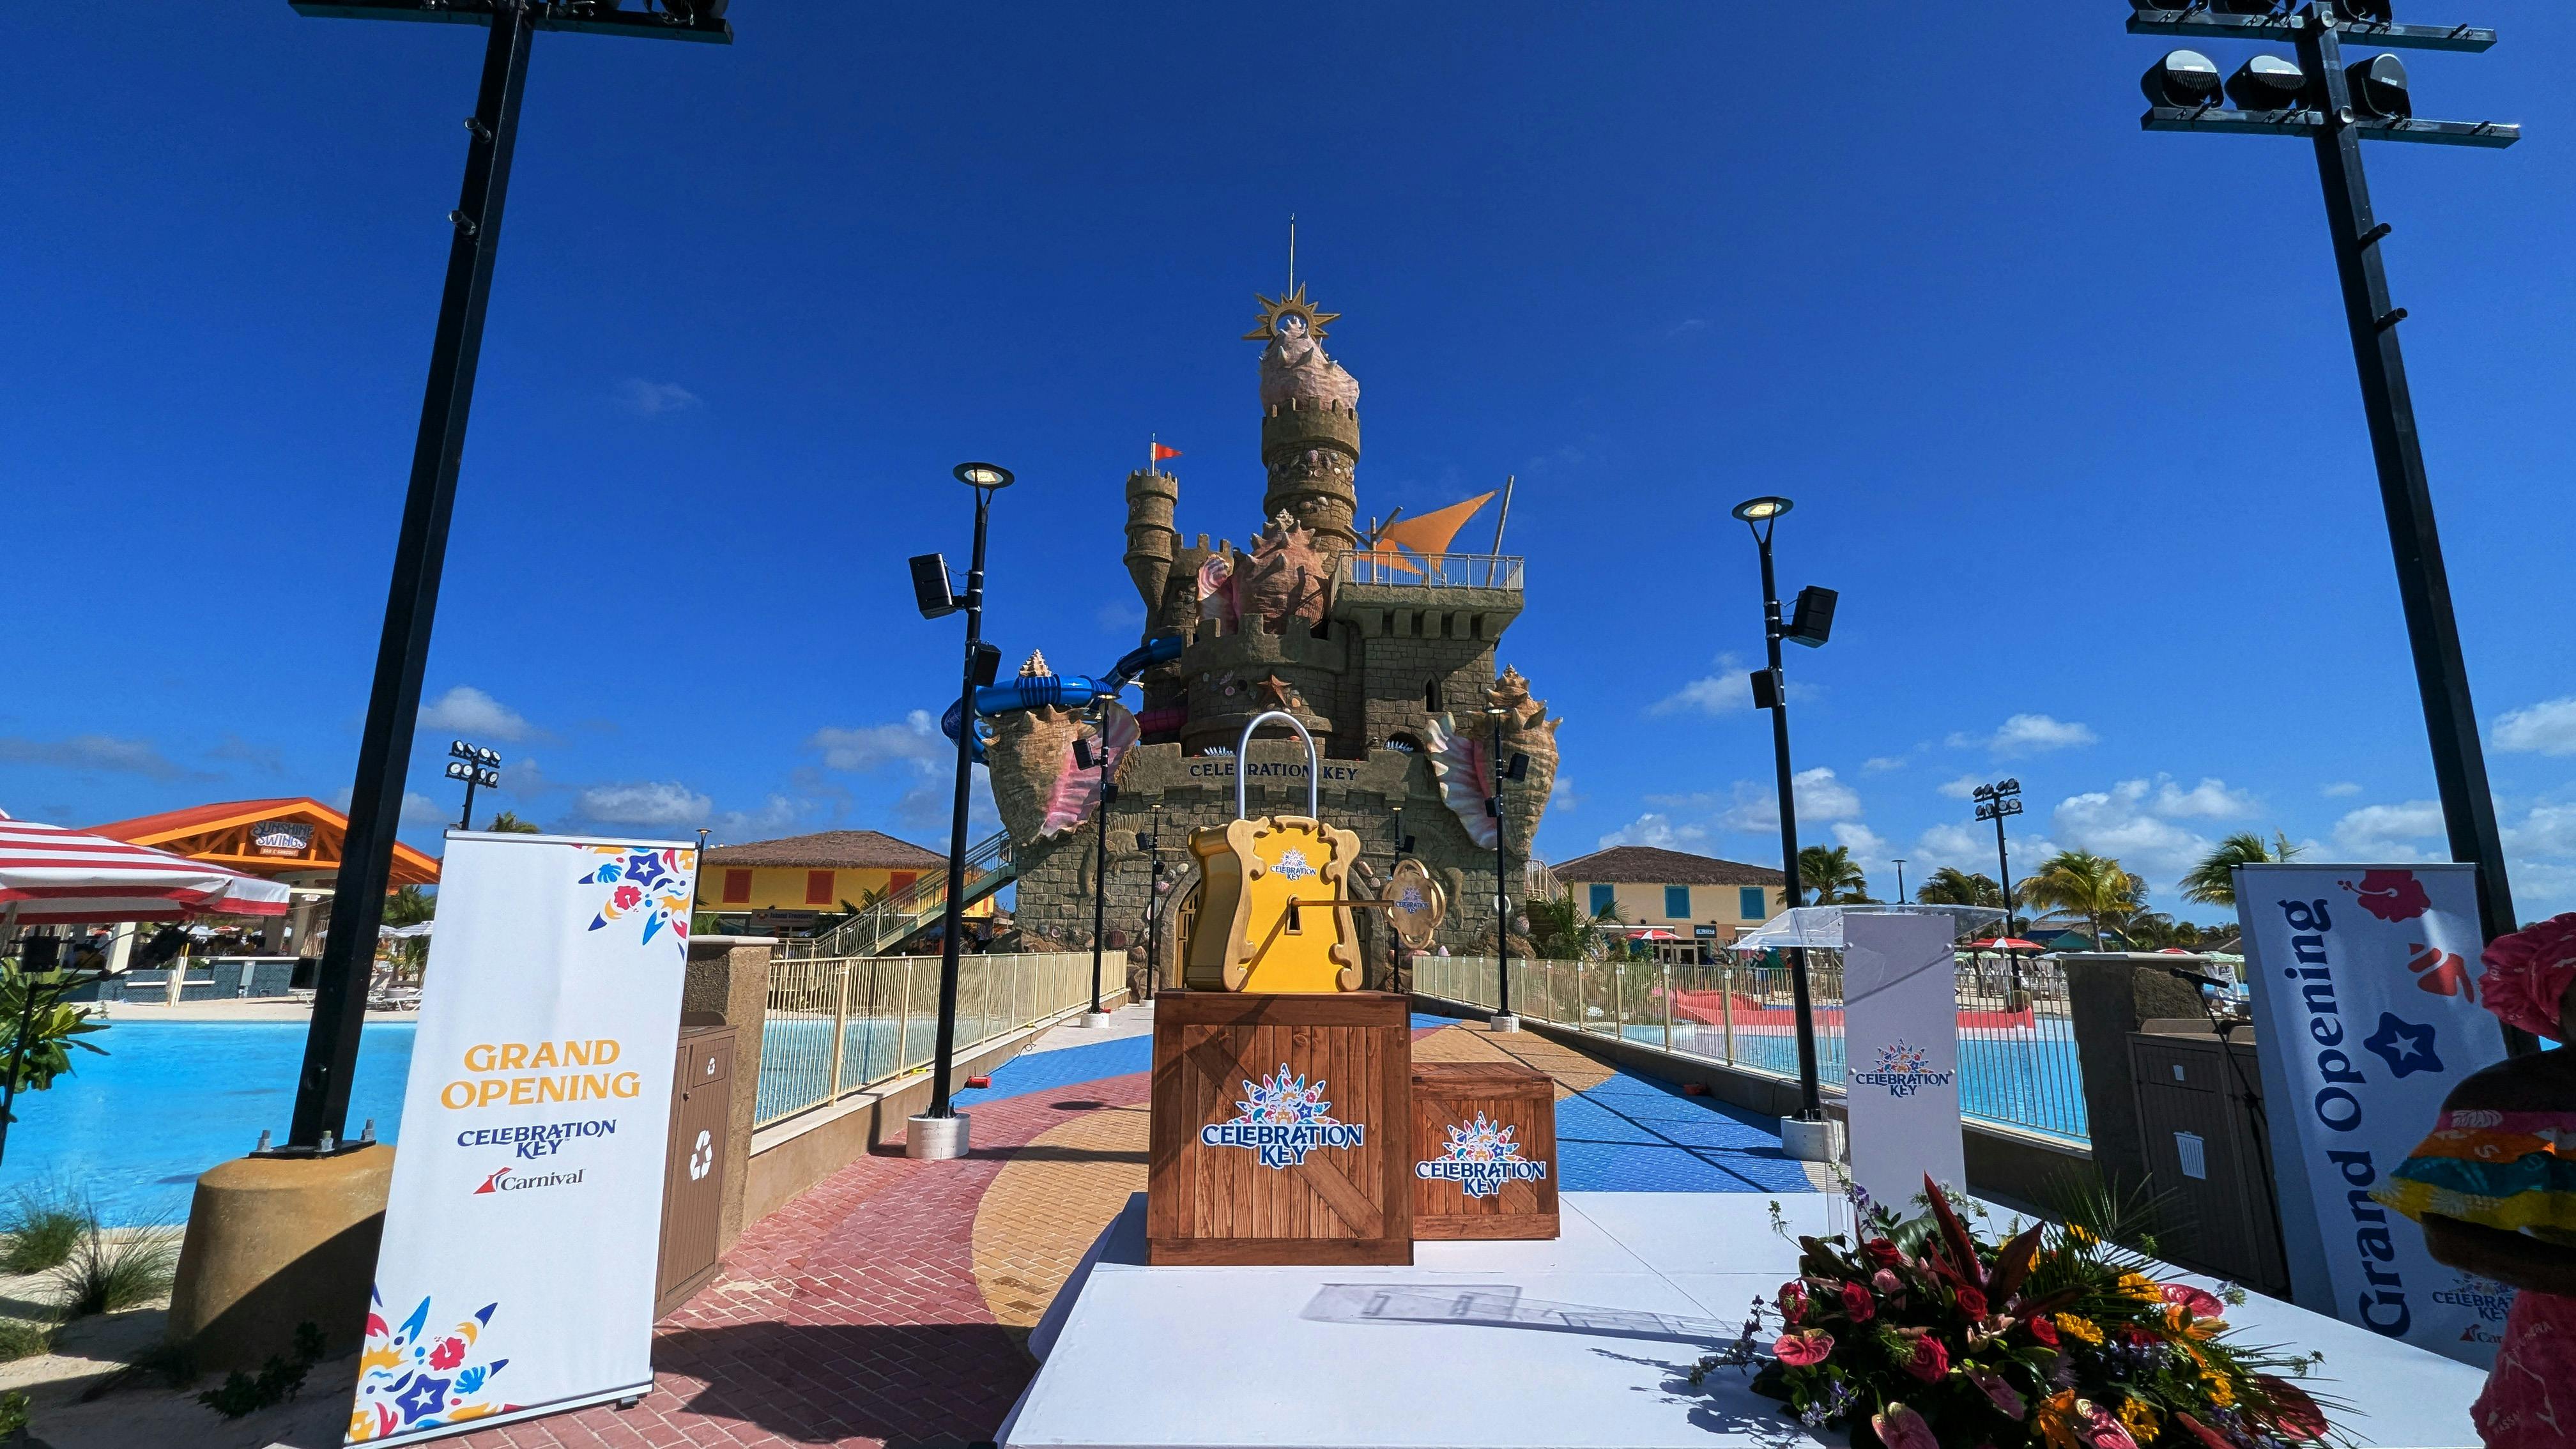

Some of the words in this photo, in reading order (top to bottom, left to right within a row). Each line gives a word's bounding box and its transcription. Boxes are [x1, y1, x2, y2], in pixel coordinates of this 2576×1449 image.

[1190, 763, 1309, 777] CELERATION
[1323, 766, 1359, 780] KEY
[251, 821, 314, 838] SUNSHINE
[256, 834, 306, 848] SWINGS
[1270, 865, 1316, 875] CELEBRATION
[1287, 873, 1301, 881] KEY
[1395, 901, 1429, 910] CELEBRATION
[2277, 899, 2366, 1132] Opening
[464, 1039, 620, 1072] GRAND
[1855, 1073, 1950, 1086] CELEBRATION
[441, 1071, 641, 1110] OPENING
[1890, 1085, 1917, 1098] KEY
[457, 1119, 617, 1147] CELEBRATION
[1202, 1125, 1363, 1148] CELEBRATION
[516, 1139, 564, 1160] KEY
[1260, 1145, 1308, 1168] KEY
[500, 1169, 584, 1191] Carnival
[1416, 1162, 1546, 1181] CELEBRATION
[1464, 1178, 1502, 1197] KEY
[2326, 1150, 2411, 1338] Grand
[2432, 1291, 2513, 1309] CELEBRA
